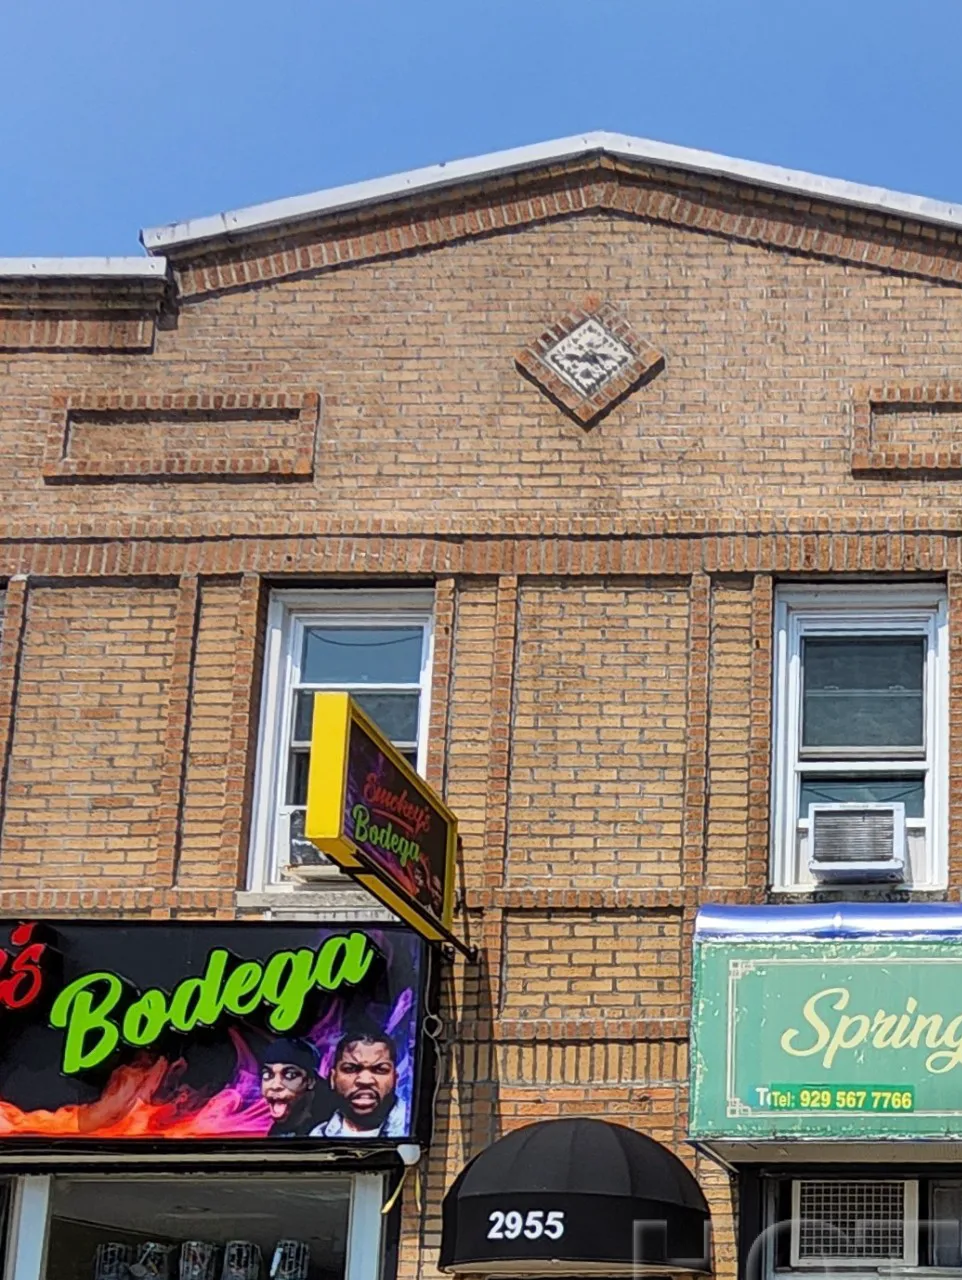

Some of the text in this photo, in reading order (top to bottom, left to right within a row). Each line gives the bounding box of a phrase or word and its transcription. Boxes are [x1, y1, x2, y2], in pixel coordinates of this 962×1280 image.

[352, 803, 420, 868] Bodega
[0, 922, 375, 1074] 's Bodega
[771, 1090, 913, 1109] Tel: 929 567 7766
[487, 1210, 565, 1240] 2955
